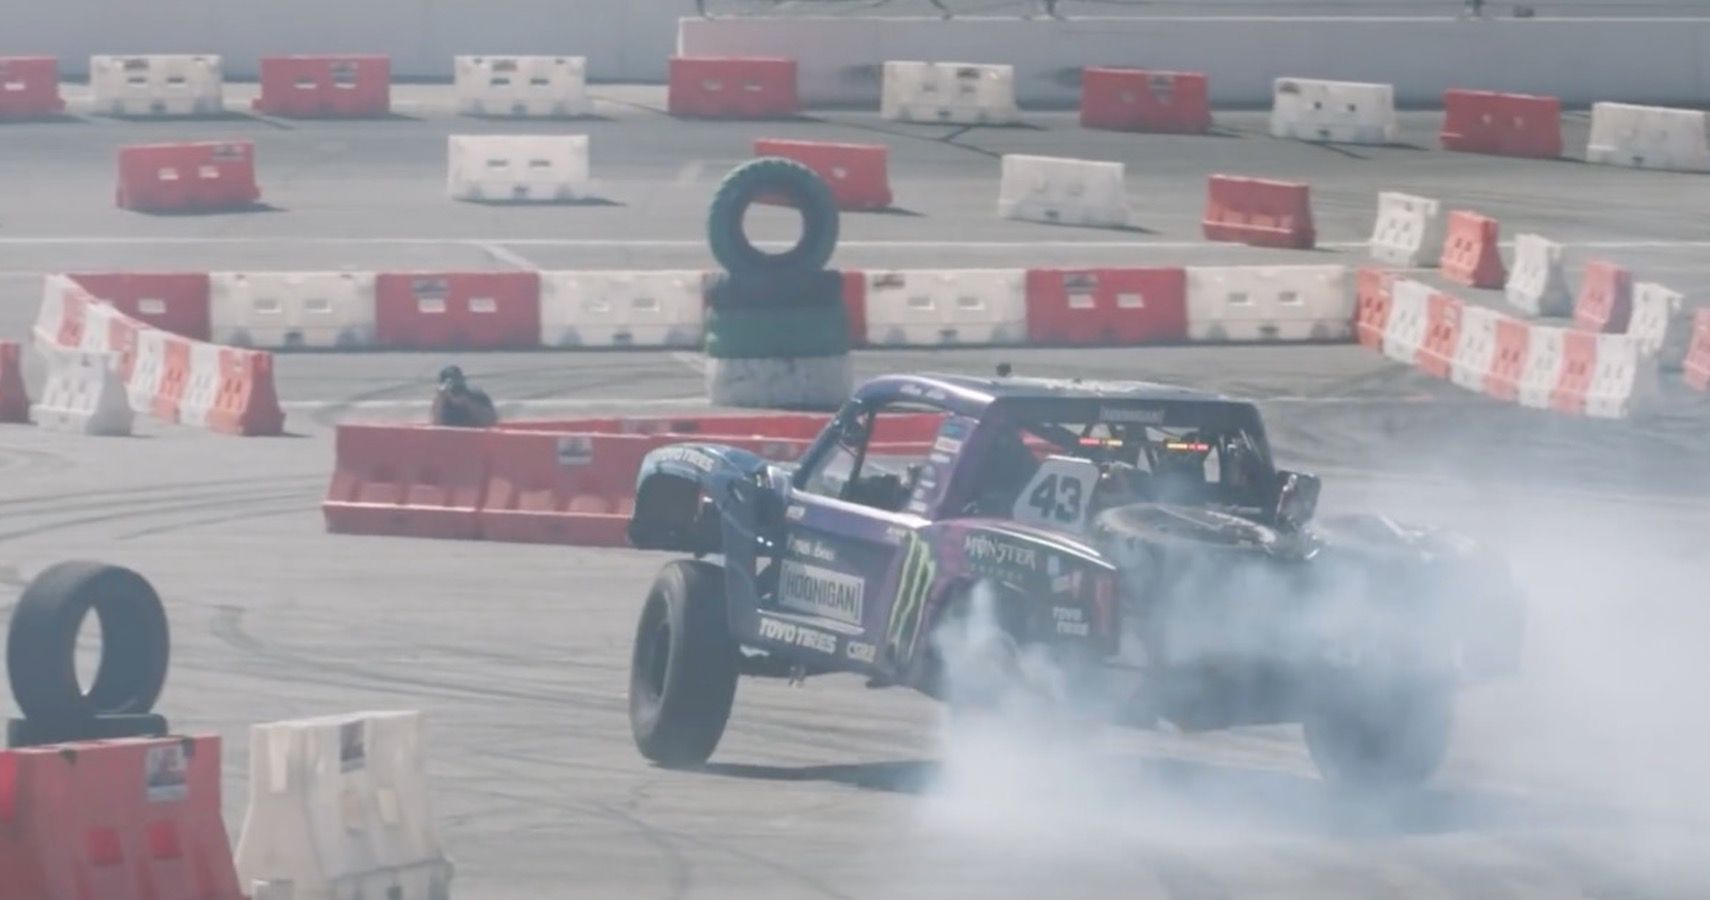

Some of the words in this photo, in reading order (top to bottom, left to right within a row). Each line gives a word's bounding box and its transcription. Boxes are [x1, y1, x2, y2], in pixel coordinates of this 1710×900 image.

[1028, 473, 1083, 524] 43
[964, 534, 1037, 572] MONSTER
[759, 617, 796, 643] TOYO
[795, 626, 837, 654] TIRES
